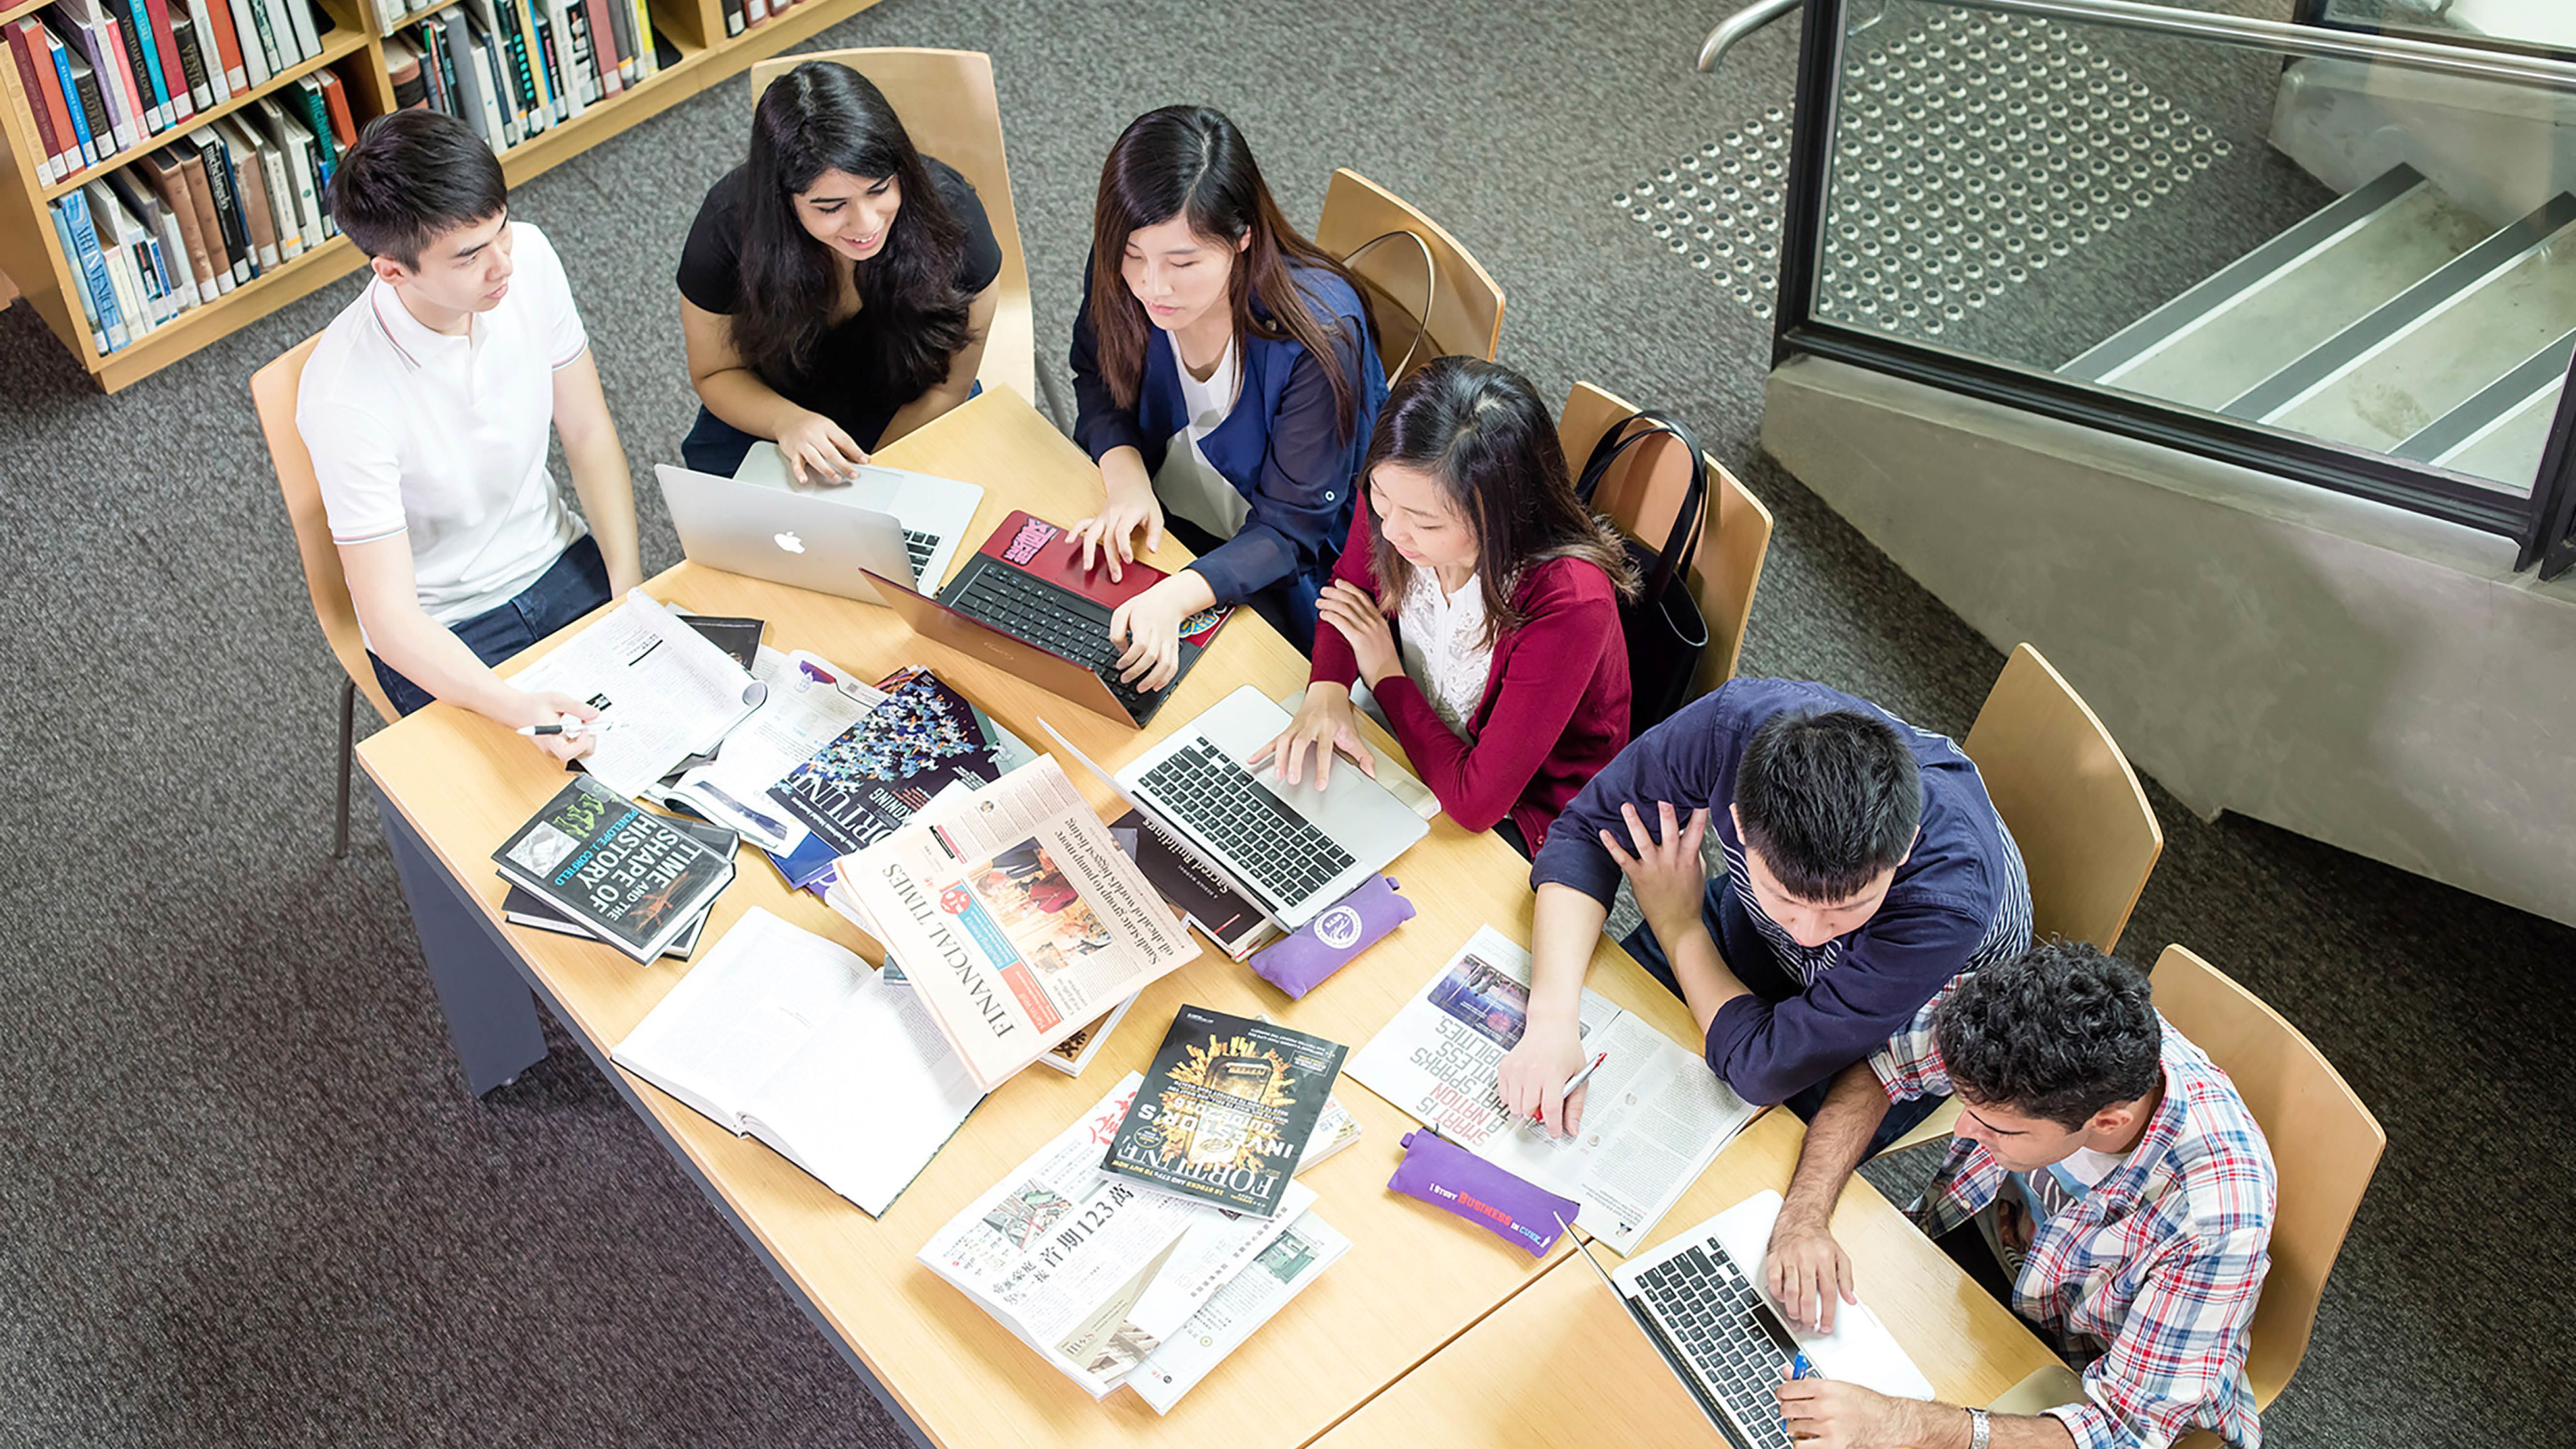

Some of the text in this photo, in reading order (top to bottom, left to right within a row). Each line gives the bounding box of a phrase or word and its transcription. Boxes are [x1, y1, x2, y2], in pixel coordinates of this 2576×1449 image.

[121, 15, 142, 61] VENETIAN
[134, 60, 153, 100] COLOUR
[180, 43, 203, 88] VENIC
[79, 86, 104, 135] FLOREN
[205, 145, 231, 210] michelangelo
[75, 225, 96, 253] ART
[89, 264, 116, 318] VENICE
[868, 786, 913, 823] KONING
[553, 808, 638, 887] PENELOPE J. CORFIELD
[576, 814, 658, 890] HISTORY
[1061, 816, 1090, 848] listing
[1140, 816, 1232, 894] Sacred Buildings
[587, 826, 679, 914] SHAPE OF
[606, 840, 702, 921] TIME AND THE
[1082, 845, 1113, 879] biggest
[1177, 863, 1197, 882] MANUAL
[1195, 879, 1214, 896] DESIGN
[881, 862, 935, 925] TIMES
[1052, 828, 1161, 966] Saudi state group to pump more
[1128, 905, 1145, 919] of
[963, 916, 984, 939] America
[1136, 914, 1165, 947] ahead
[1157, 941, 1175, 958] oil
[924, 921, 1016, 1039] FINANCIAL
[1028, 1007, 1047, 1030] Martin
[1434, 1014, 1506, 1069] IBILITIES.
[1409, 1045, 1513, 1121] THAT SPARKS
[1435, 1039, 1500, 1089] NTLESS
[1136, 1102, 1294, 1158] INVESTOR'S
[1172, 1096, 1274, 1134] GUIDE 2016
[1414, 1095, 1491, 1147] SMART IS
[1429, 1081, 1504, 1134] A NATION
[1111, 1159, 1129, 1169] NOW
[1116, 1135, 1277, 1199] FORTUNE
[1171, 1176, 1185, 1185] AND
[1185, 1180, 1213, 1193] STOCKS
[1036, 1181, 1135, 1269] 首期123萬
